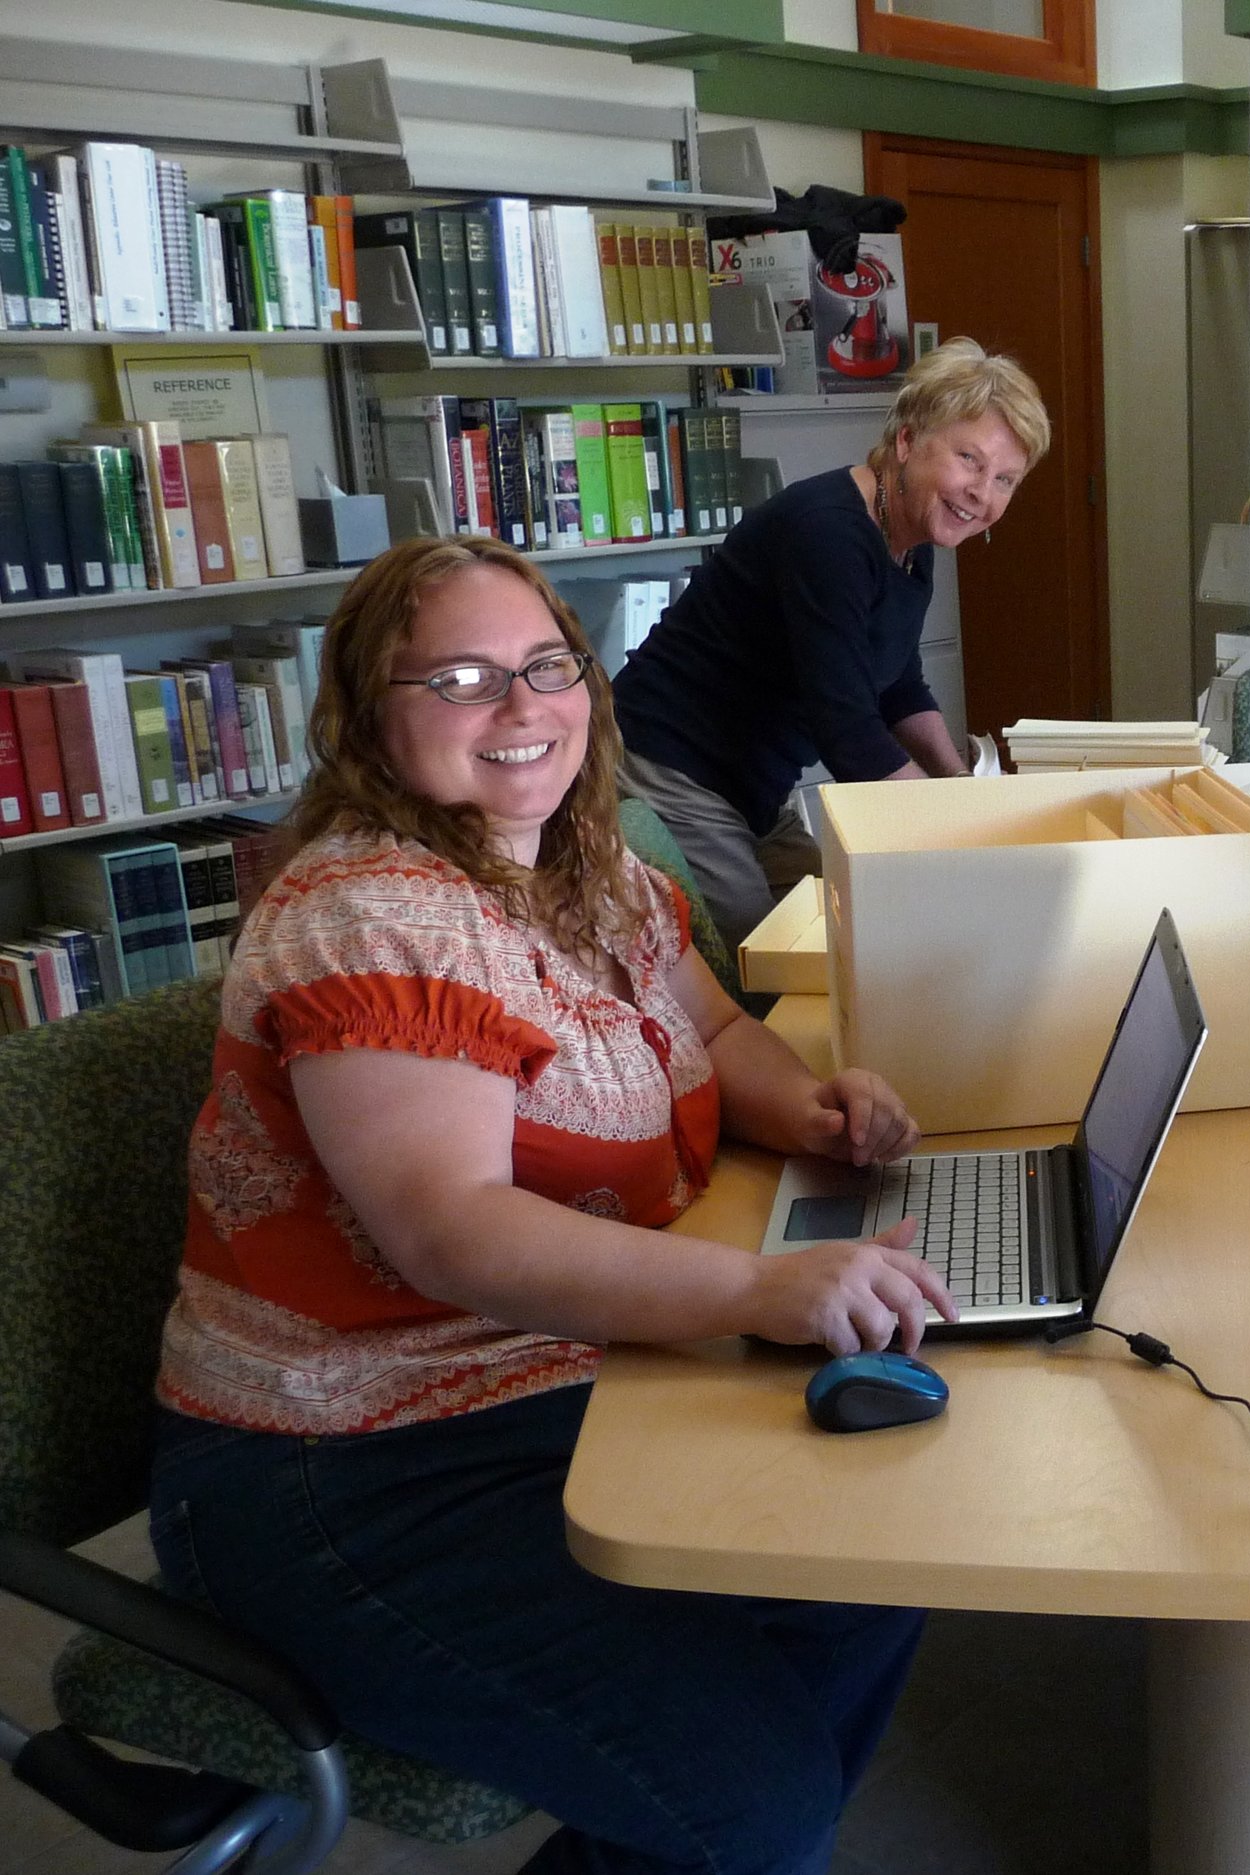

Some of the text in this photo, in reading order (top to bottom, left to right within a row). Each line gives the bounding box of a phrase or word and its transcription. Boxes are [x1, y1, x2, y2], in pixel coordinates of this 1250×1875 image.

[750, 255, 775, 268] TRIO
[153, 377, 232, 393] REFERENCE
[451, 441, 467, 517] BOTANICA
